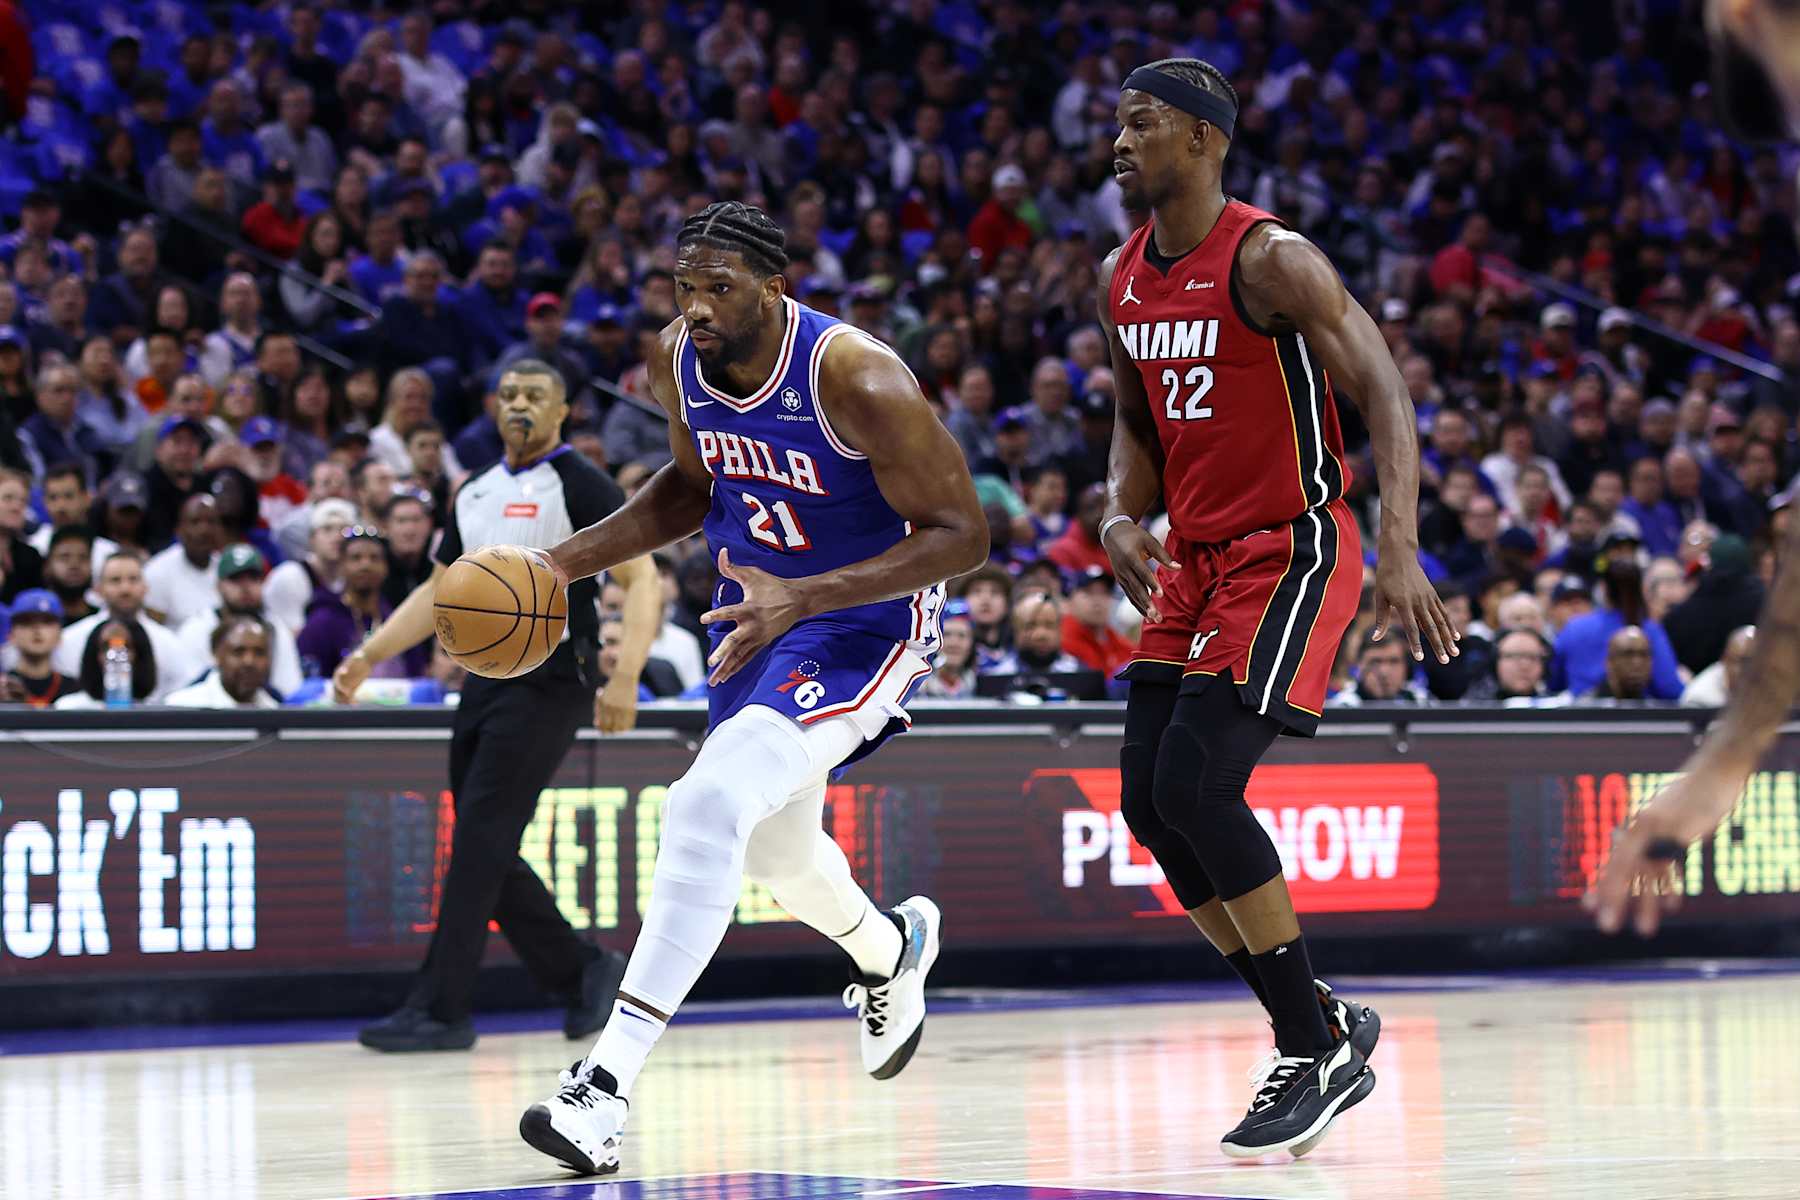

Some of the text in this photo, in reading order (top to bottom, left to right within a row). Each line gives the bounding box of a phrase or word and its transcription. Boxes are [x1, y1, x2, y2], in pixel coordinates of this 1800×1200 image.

[1117, 319, 1219, 360] MIAMI
[776, 413, 815, 422] crypto.com
[1161, 365, 1214, 420] 22
[696, 430, 829, 496] PHILA
[741, 491, 812, 550] 21
[0, 787, 256, 958] ck'Em
[1062, 803, 1405, 888] PL NOW
